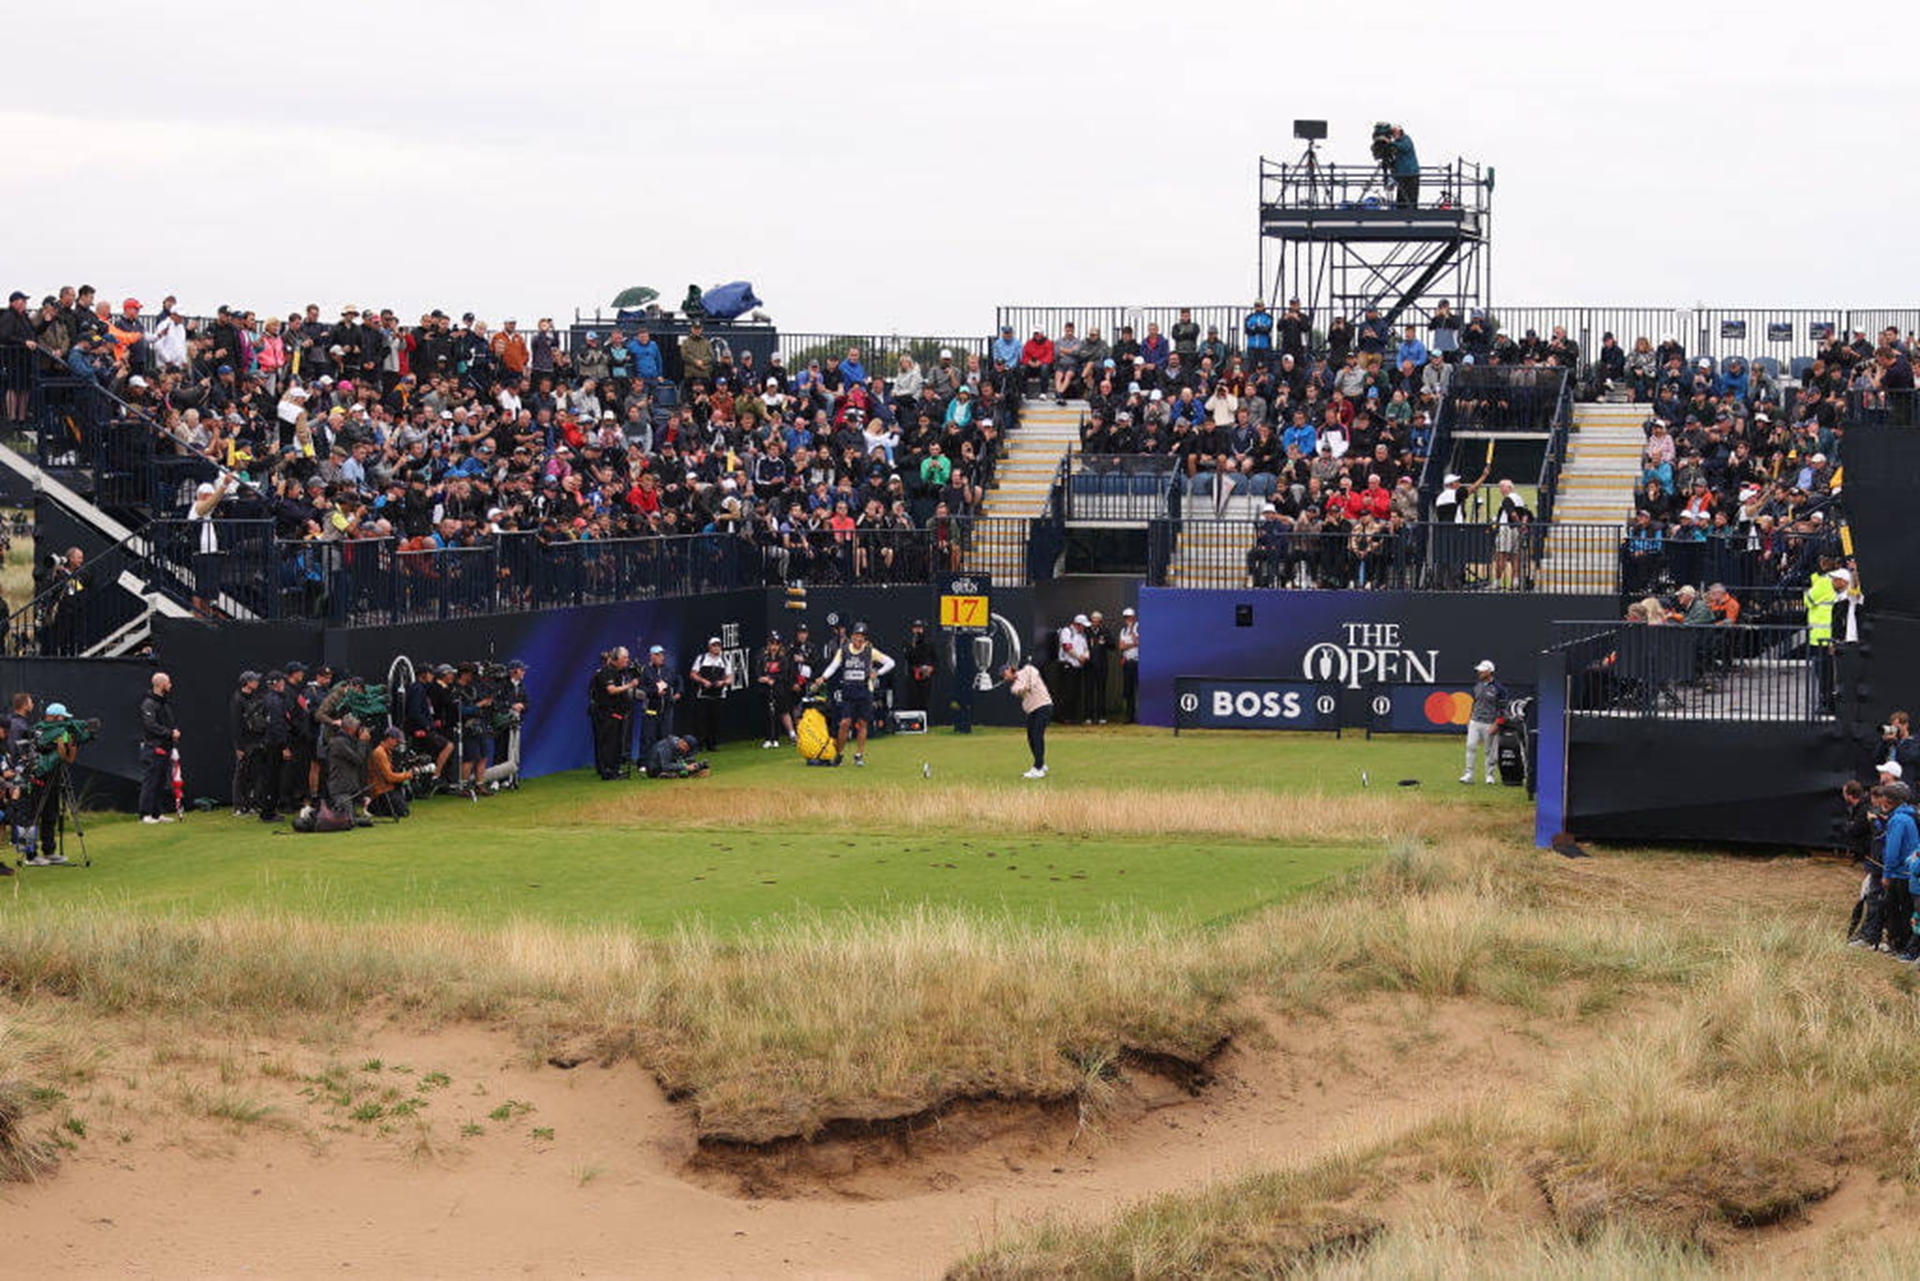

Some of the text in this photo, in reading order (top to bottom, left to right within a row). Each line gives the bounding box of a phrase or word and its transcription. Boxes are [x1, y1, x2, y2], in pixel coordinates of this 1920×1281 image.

[951, 599, 979, 622] 17
[722, 623, 740, 648] THE
[1342, 623, 1402, 647] THE
[724, 648, 750, 690] PEN
[1303, 642, 1440, 689] OPEN
[1213, 691, 1301, 718] BOSS
